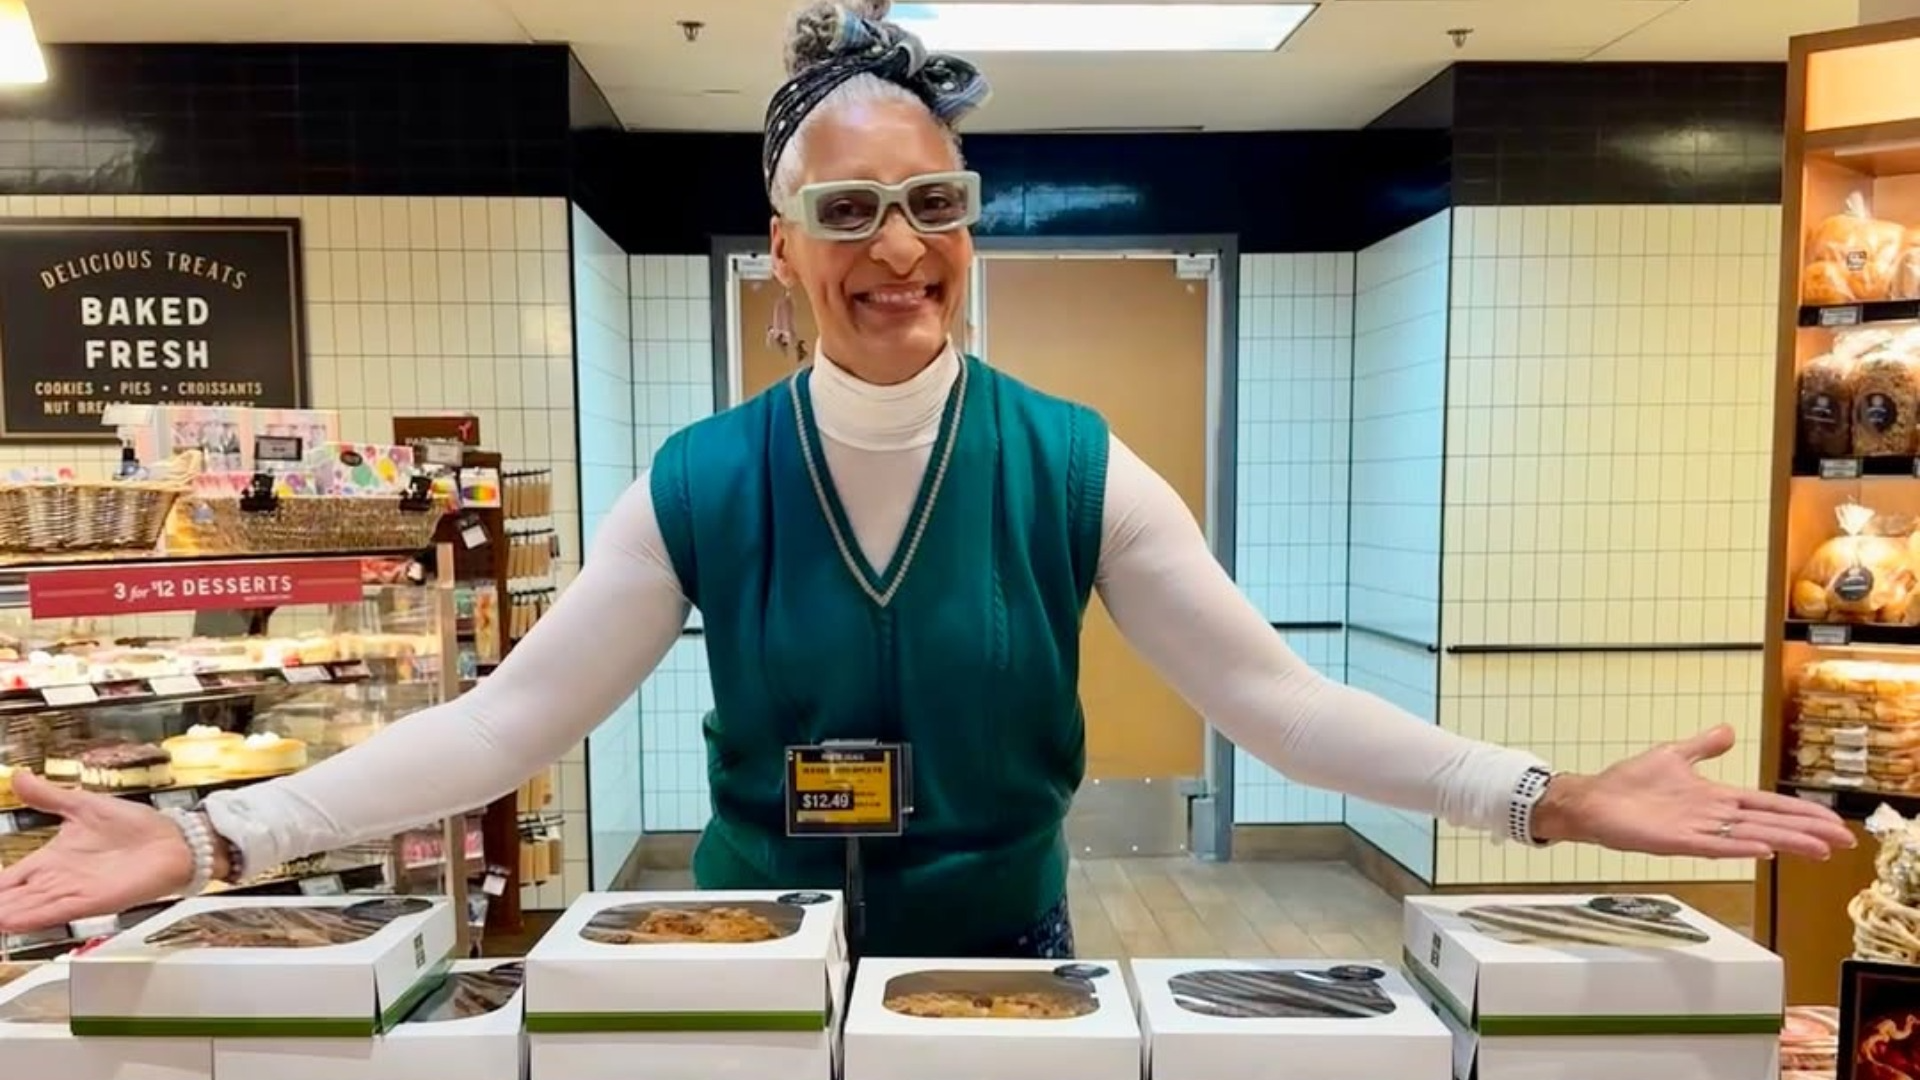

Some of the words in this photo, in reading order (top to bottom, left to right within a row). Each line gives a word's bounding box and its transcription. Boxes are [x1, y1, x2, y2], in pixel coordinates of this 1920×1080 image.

[40, 249, 152, 290] DELICIOUS
[166, 250, 248, 290] TREATS
[81, 297, 210, 326] BAKED
[85, 340, 209, 369] FRESH
[35, 382, 94, 396] COOKIES
[120, 382, 152, 395] PIES
[178, 382, 263, 396] CROISSANTS
[44, 401, 70, 414] NUT
[114, 582, 126, 600] 3
[128, 585, 150, 603] for
[182, 575, 293, 596] DESSERTS
[802, 793, 849, 809] $12.49
